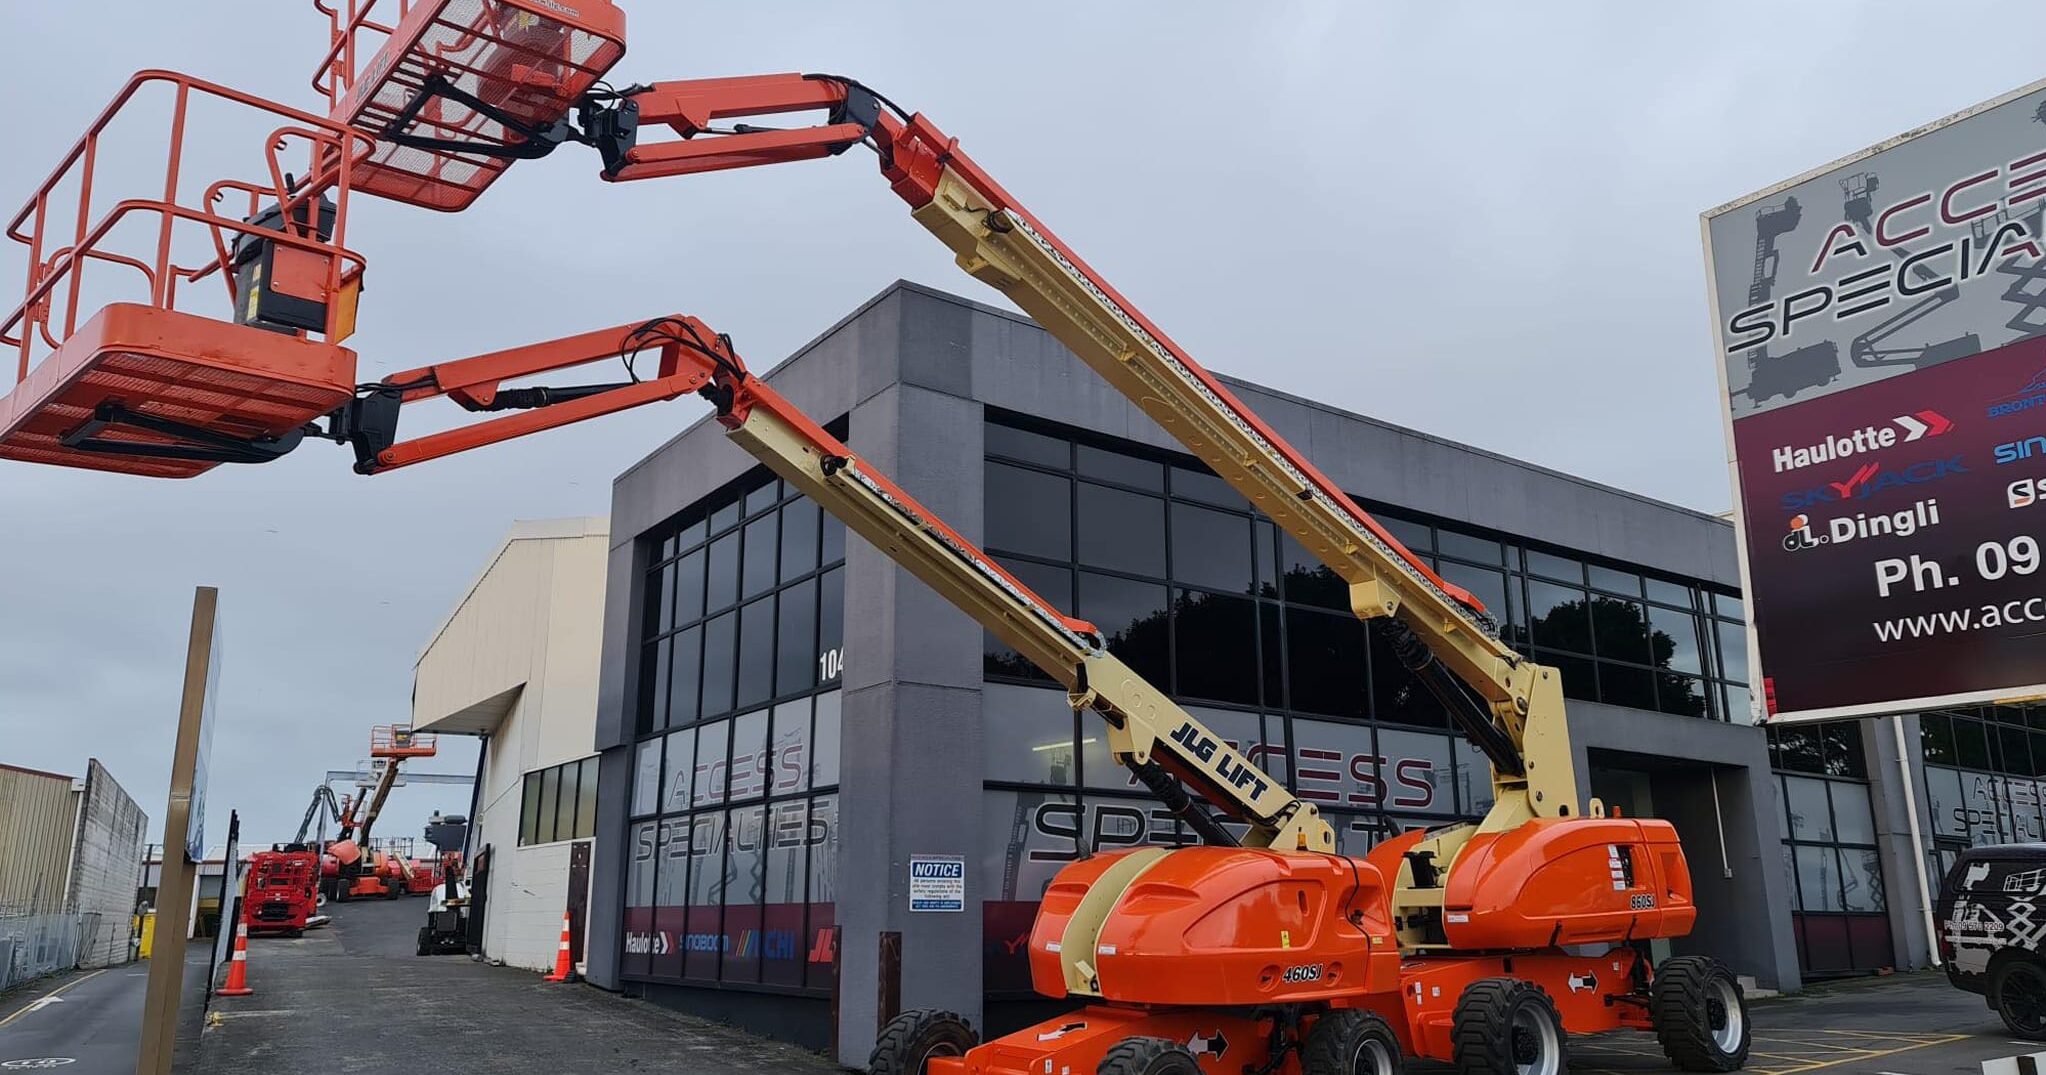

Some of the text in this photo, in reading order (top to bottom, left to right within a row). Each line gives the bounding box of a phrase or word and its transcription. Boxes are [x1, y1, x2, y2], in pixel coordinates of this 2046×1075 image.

[1727, 222, 2042, 353] SPECIA
[1773, 424, 1897, 473] Haulotte
[1780, 454, 1969, 510] SKYJACK
[1874, 535, 2042, 598] Ph. 09
[1873, 597, 2046, 643] www.acc
[1170, 721, 1269, 801] JLG LIFT
[915, 863, 960, 877] NOTICE
[1282, 964, 1323, 984] 460SJ
